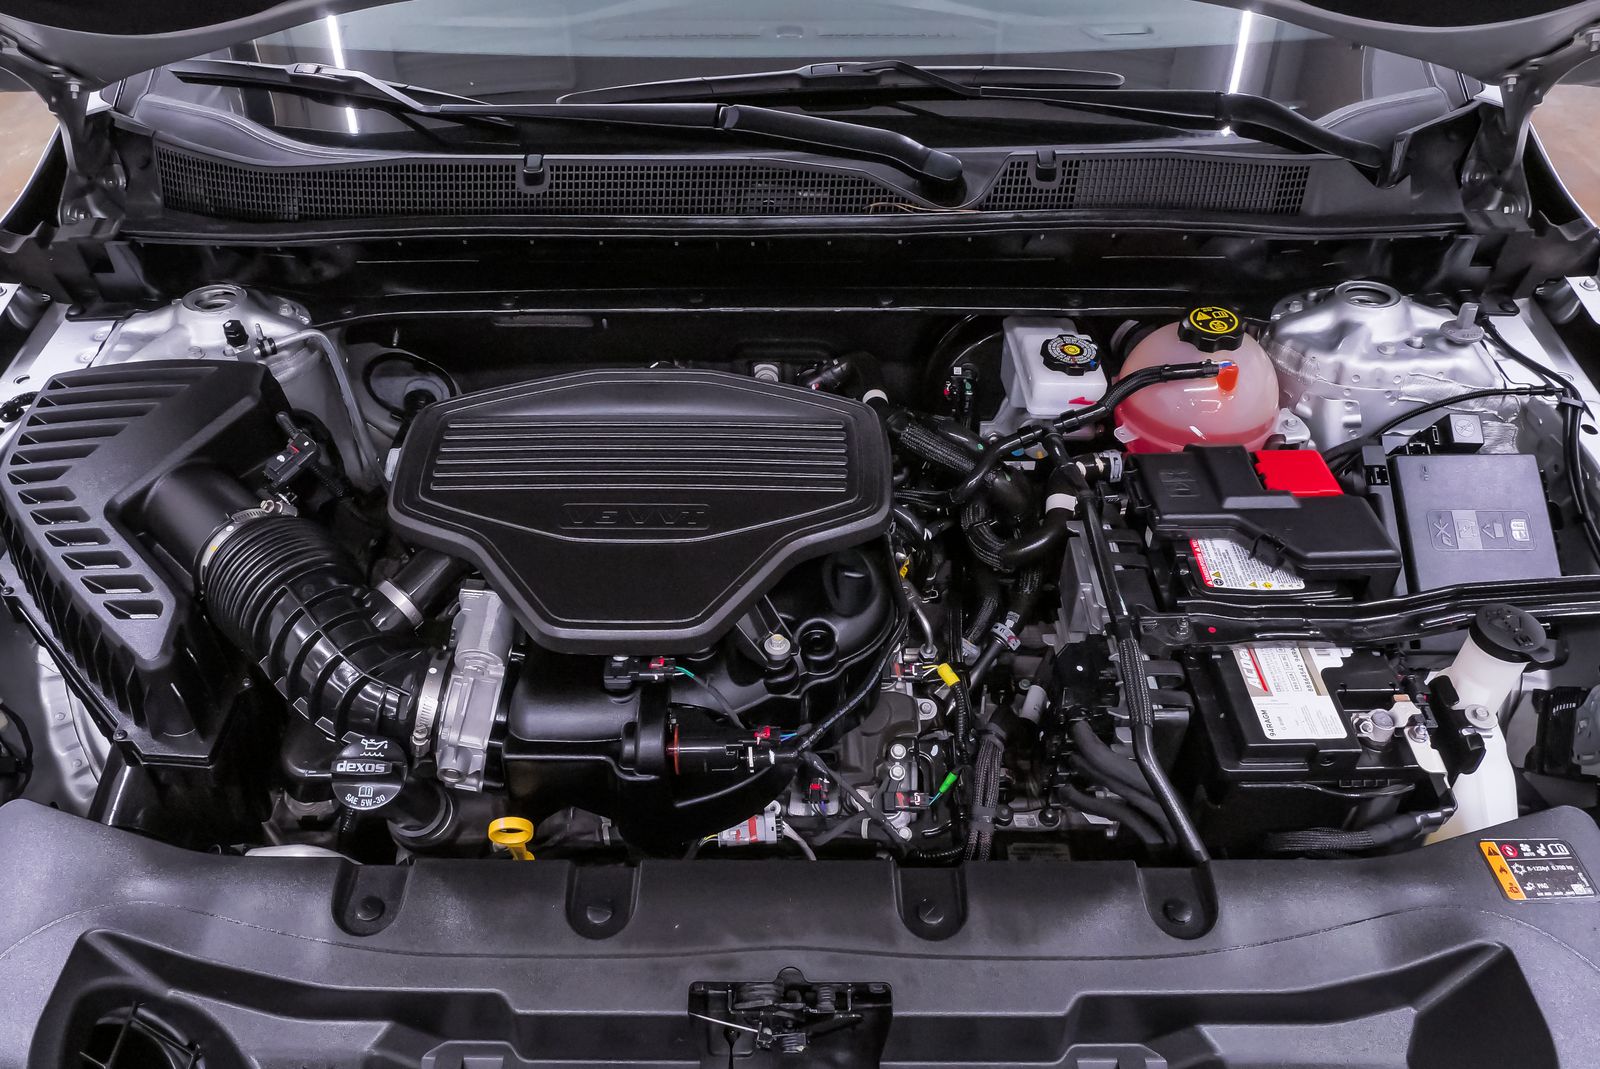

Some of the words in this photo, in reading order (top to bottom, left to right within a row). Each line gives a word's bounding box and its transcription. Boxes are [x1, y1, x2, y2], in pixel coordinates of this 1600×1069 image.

[1261, 709, 1276, 737] 94RAGM
[336, 760, 385, 773] dexos
[345, 794, 358, 804] SAE
[360, 794, 385, 806] 5W-30
